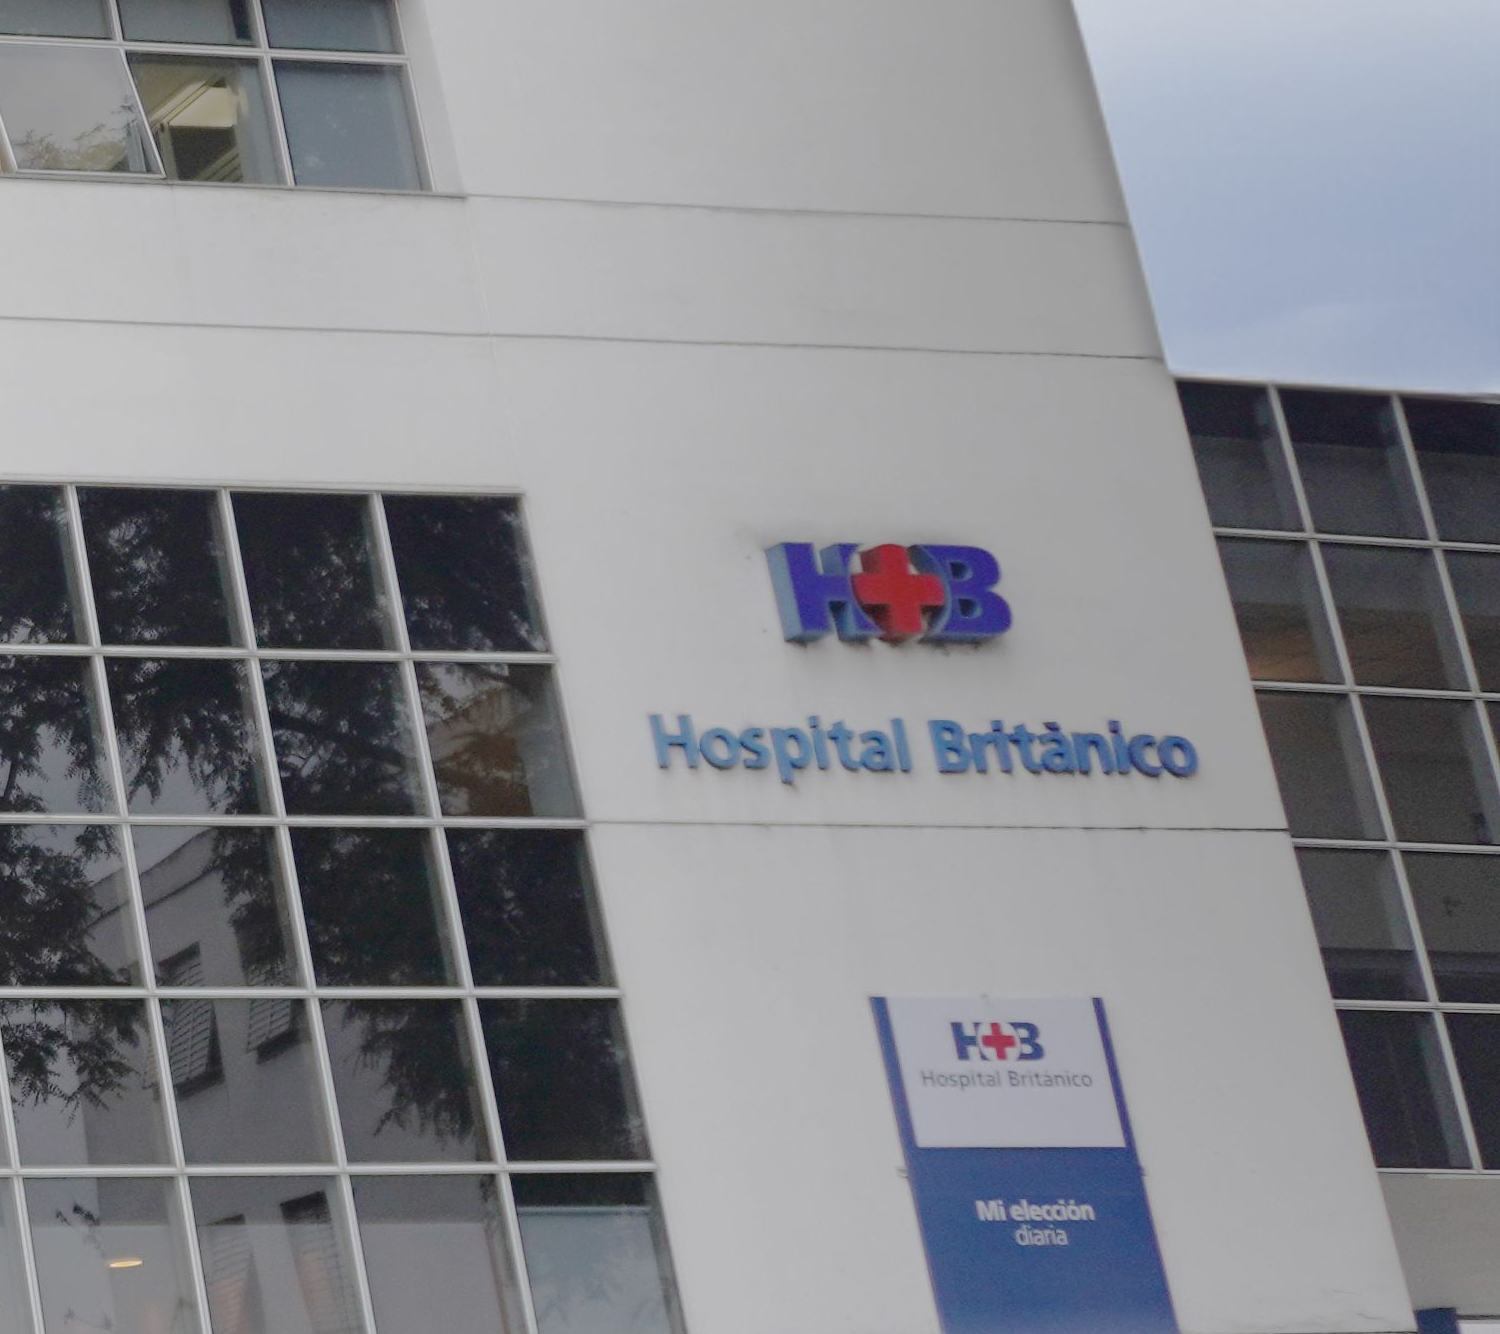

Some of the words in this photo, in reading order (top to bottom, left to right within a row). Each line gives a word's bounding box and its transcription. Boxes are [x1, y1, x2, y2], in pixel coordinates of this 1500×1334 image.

[649, 714, 911, 785] Hospital
[927, 719, 1198, 778] Británico
[920, 1070, 1001, 1092] Hospital
[975, 1199, 1007, 1221] Mi
[1009, 1198, 1096, 1221] elección
[1014, 1223, 1068, 1246] diaria
